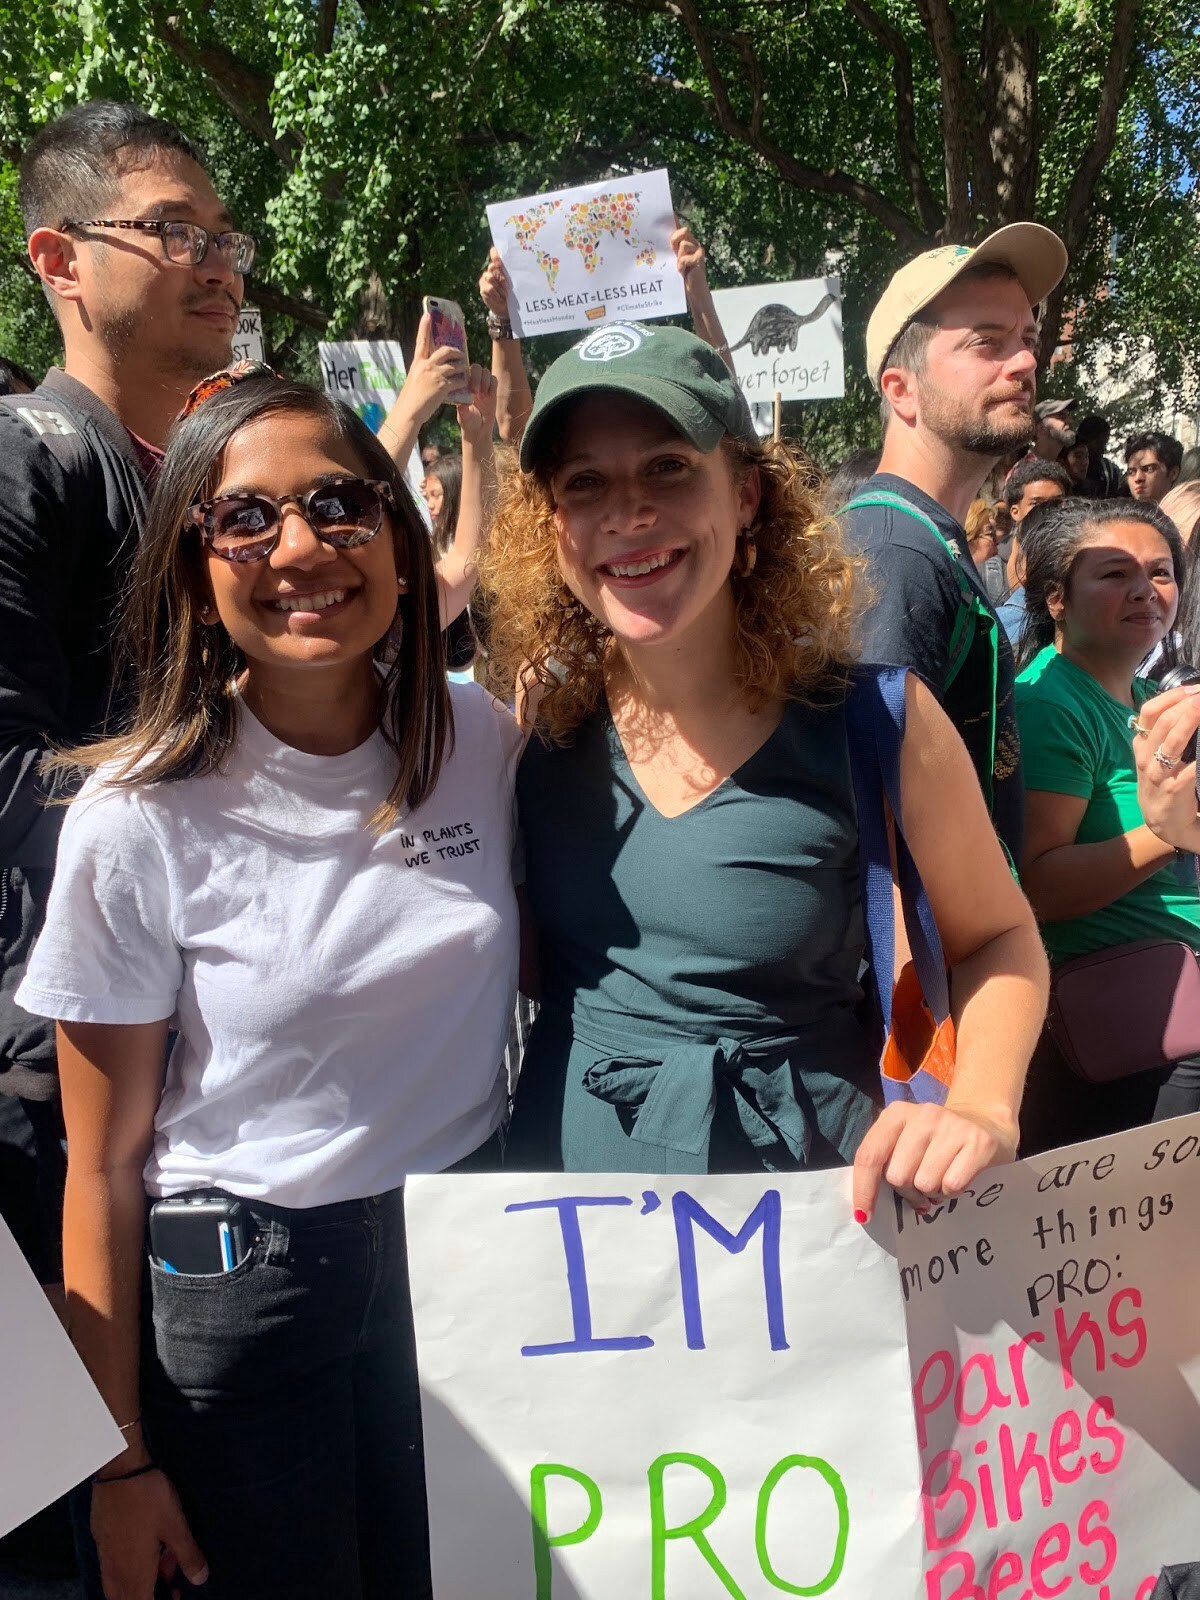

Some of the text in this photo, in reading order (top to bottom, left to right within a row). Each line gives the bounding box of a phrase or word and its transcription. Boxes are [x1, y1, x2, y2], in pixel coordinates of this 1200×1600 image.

[525, 298, 555, 313] LESS
[630, 279, 664, 296] HEAT
[616, 299, 663, 311] #ClimateStrike
[236, 318, 260, 335] OOK
[233, 343, 250, 361] ST
[324, 360, 357, 391] Her
[737, 357, 831, 393] ver forget
[405, 838, 480, 868] WE TRUST
[422, 822, 474, 843] PLANTS
[1037, 1153, 1116, 1193] are
[1144, 1135, 1200, 1171] so
[900, 1193, 1174, 1302] more things
[504, 1189, 790, 1357] I'M
[1026, 1254, 1122, 1317] PRO:
[913, 1287, 1148, 1449] Parks
[920, 1396, 1125, 1551] Bikes
[530, 1452, 850, 1600] PRO
[925, 1500, 1118, 1600] Bees
